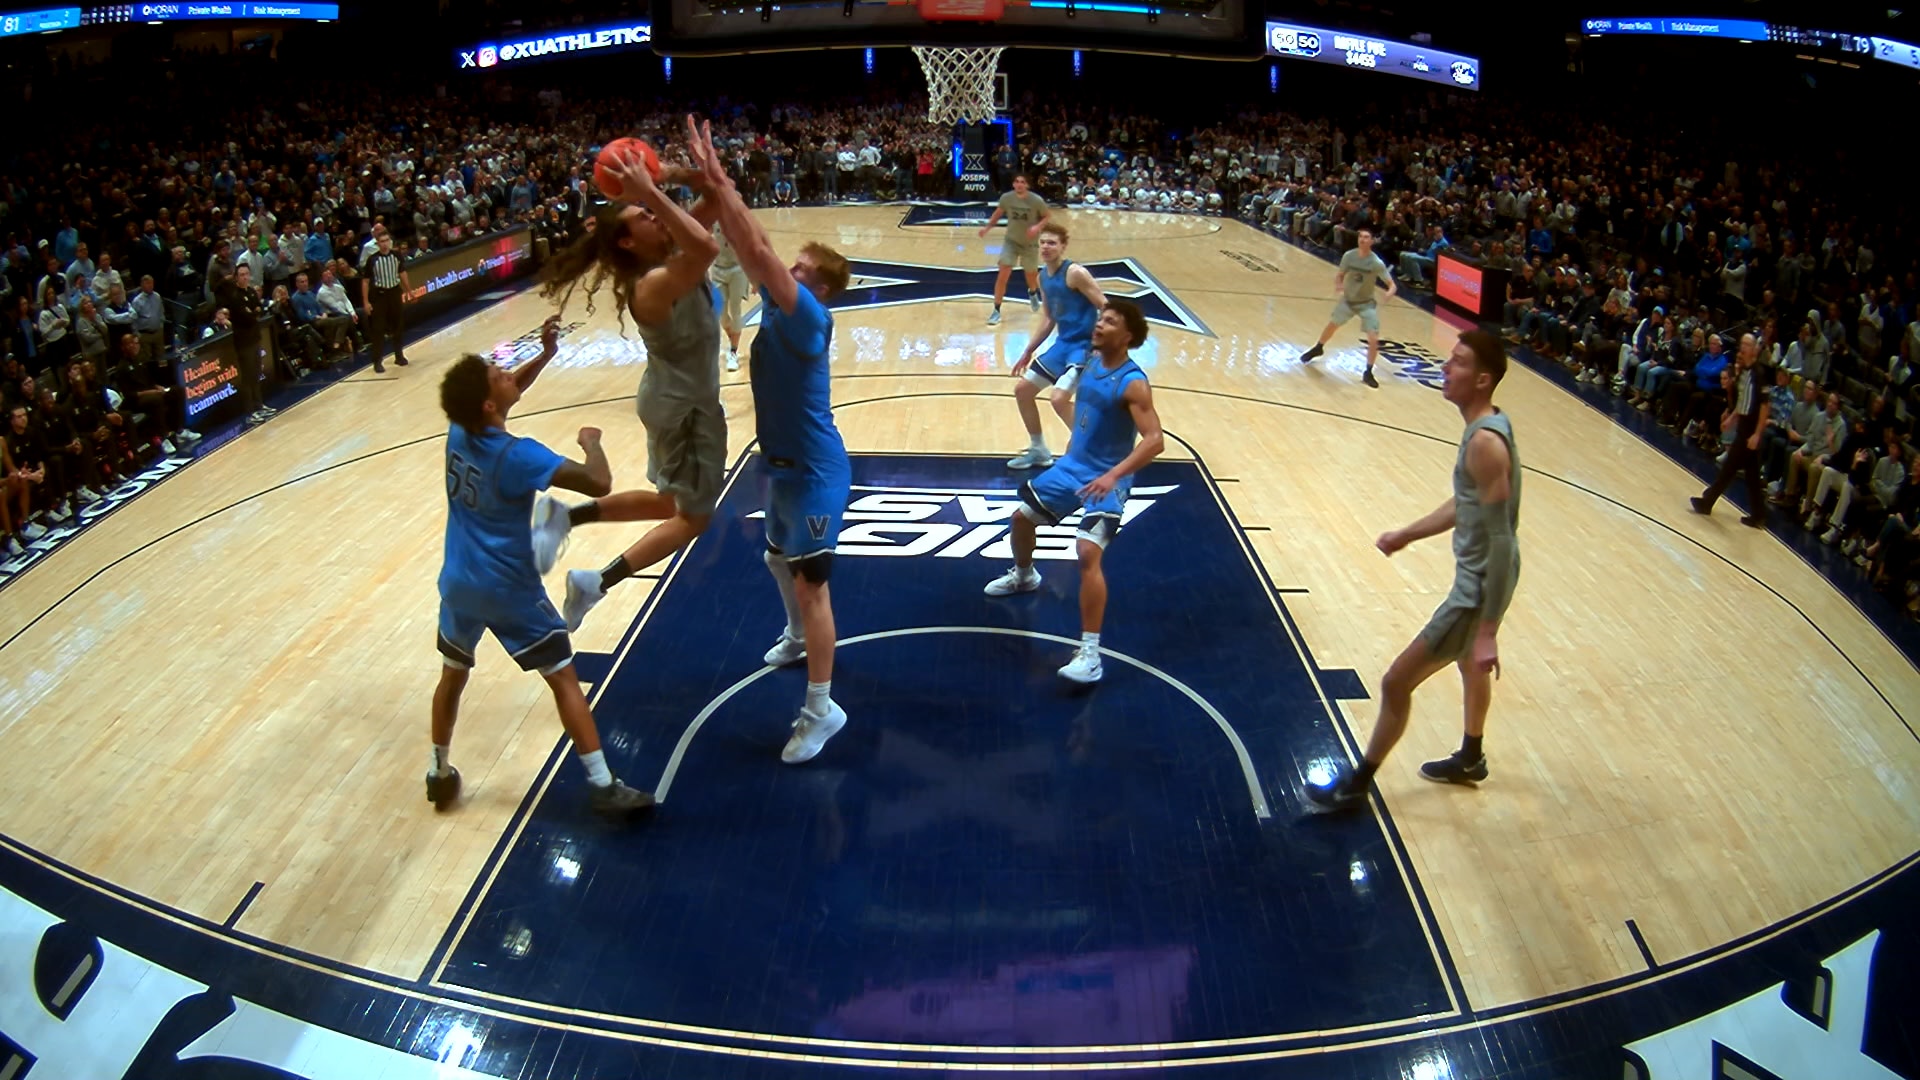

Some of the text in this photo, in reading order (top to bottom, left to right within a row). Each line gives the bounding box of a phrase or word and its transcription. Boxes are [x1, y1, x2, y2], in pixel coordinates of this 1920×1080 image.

[4, 17, 19, 32] 81
[1299, 35, 1318, 49] 50
[1853, 36, 1870, 53] 79
[960, 174, 989, 182] JOSEPH
[1011, 211, 1028, 221] 24
[427, 280, 435, 293] in
[436, 270, 458, 289] health
[183, 358, 221, 383] Healing
[185, 365, 238, 399] begins with
[188, 383, 237, 415] teamwork.
[447, 452, 482, 511] 55
[806, 514, 831, 540] V
